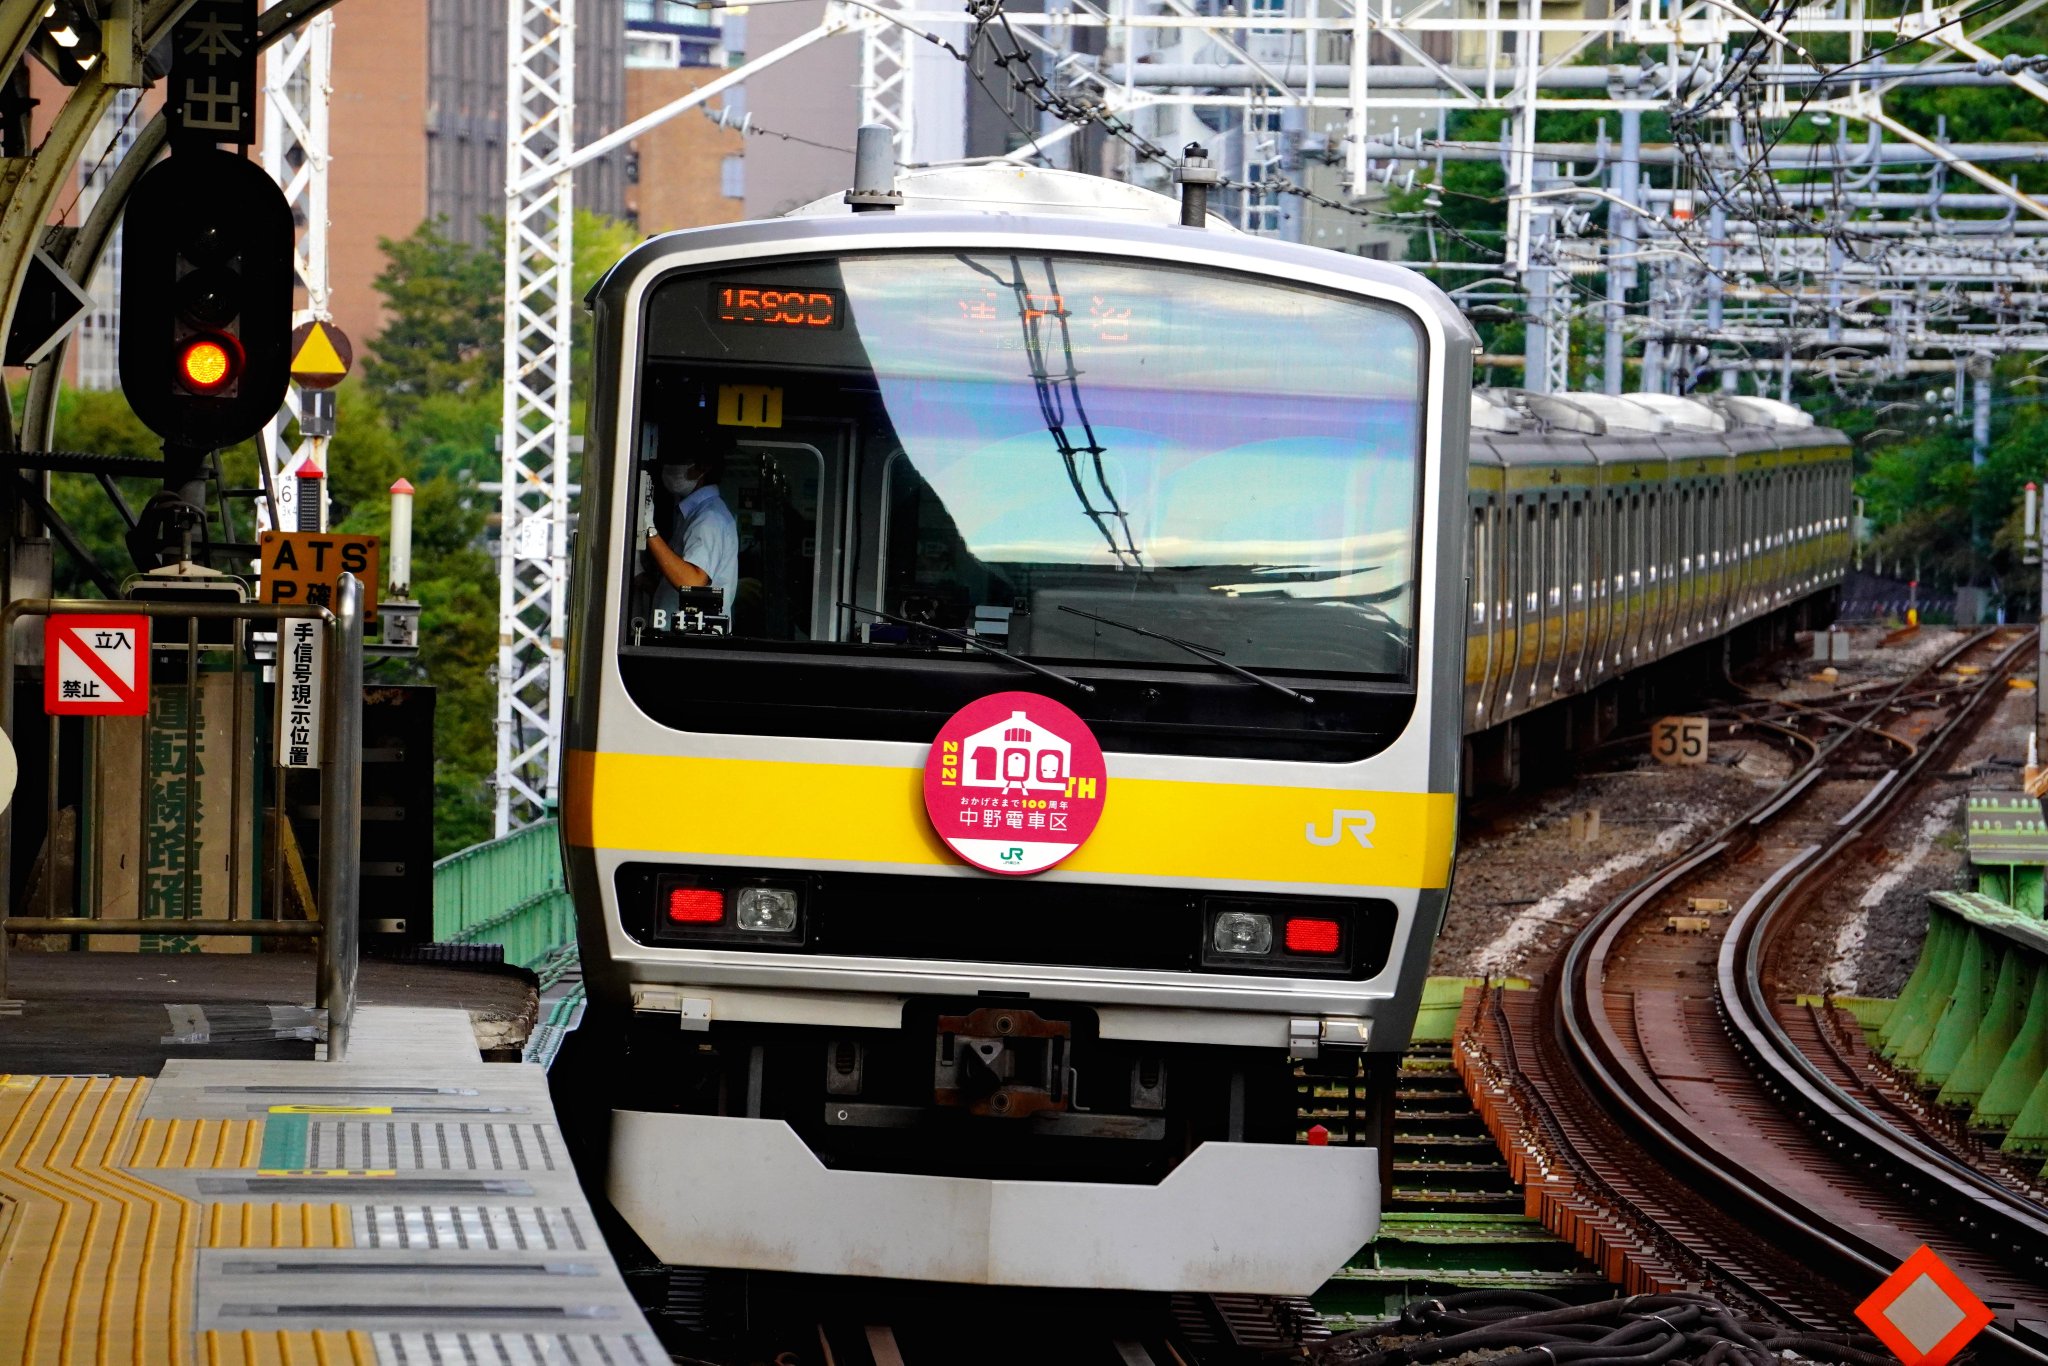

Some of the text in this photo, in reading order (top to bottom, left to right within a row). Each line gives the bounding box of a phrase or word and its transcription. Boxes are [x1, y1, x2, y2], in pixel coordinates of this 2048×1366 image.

[183, 0, 242, 131] 本出
[272, 539, 368, 573] ATS
[272, 580, 332, 609] P確
[95, 631, 131, 650] 立入
[63, 680, 100, 698] 禁止
[289, 622, 314, 766] 手信号現示位置
[1659, 724, 1703, 757] 35
[941, 740, 959, 786] 2021
[959, 807, 1069, 831] 中野電車区
[1305, 808, 1376, 849] JR
[1000, 847, 1024, 861] JR
